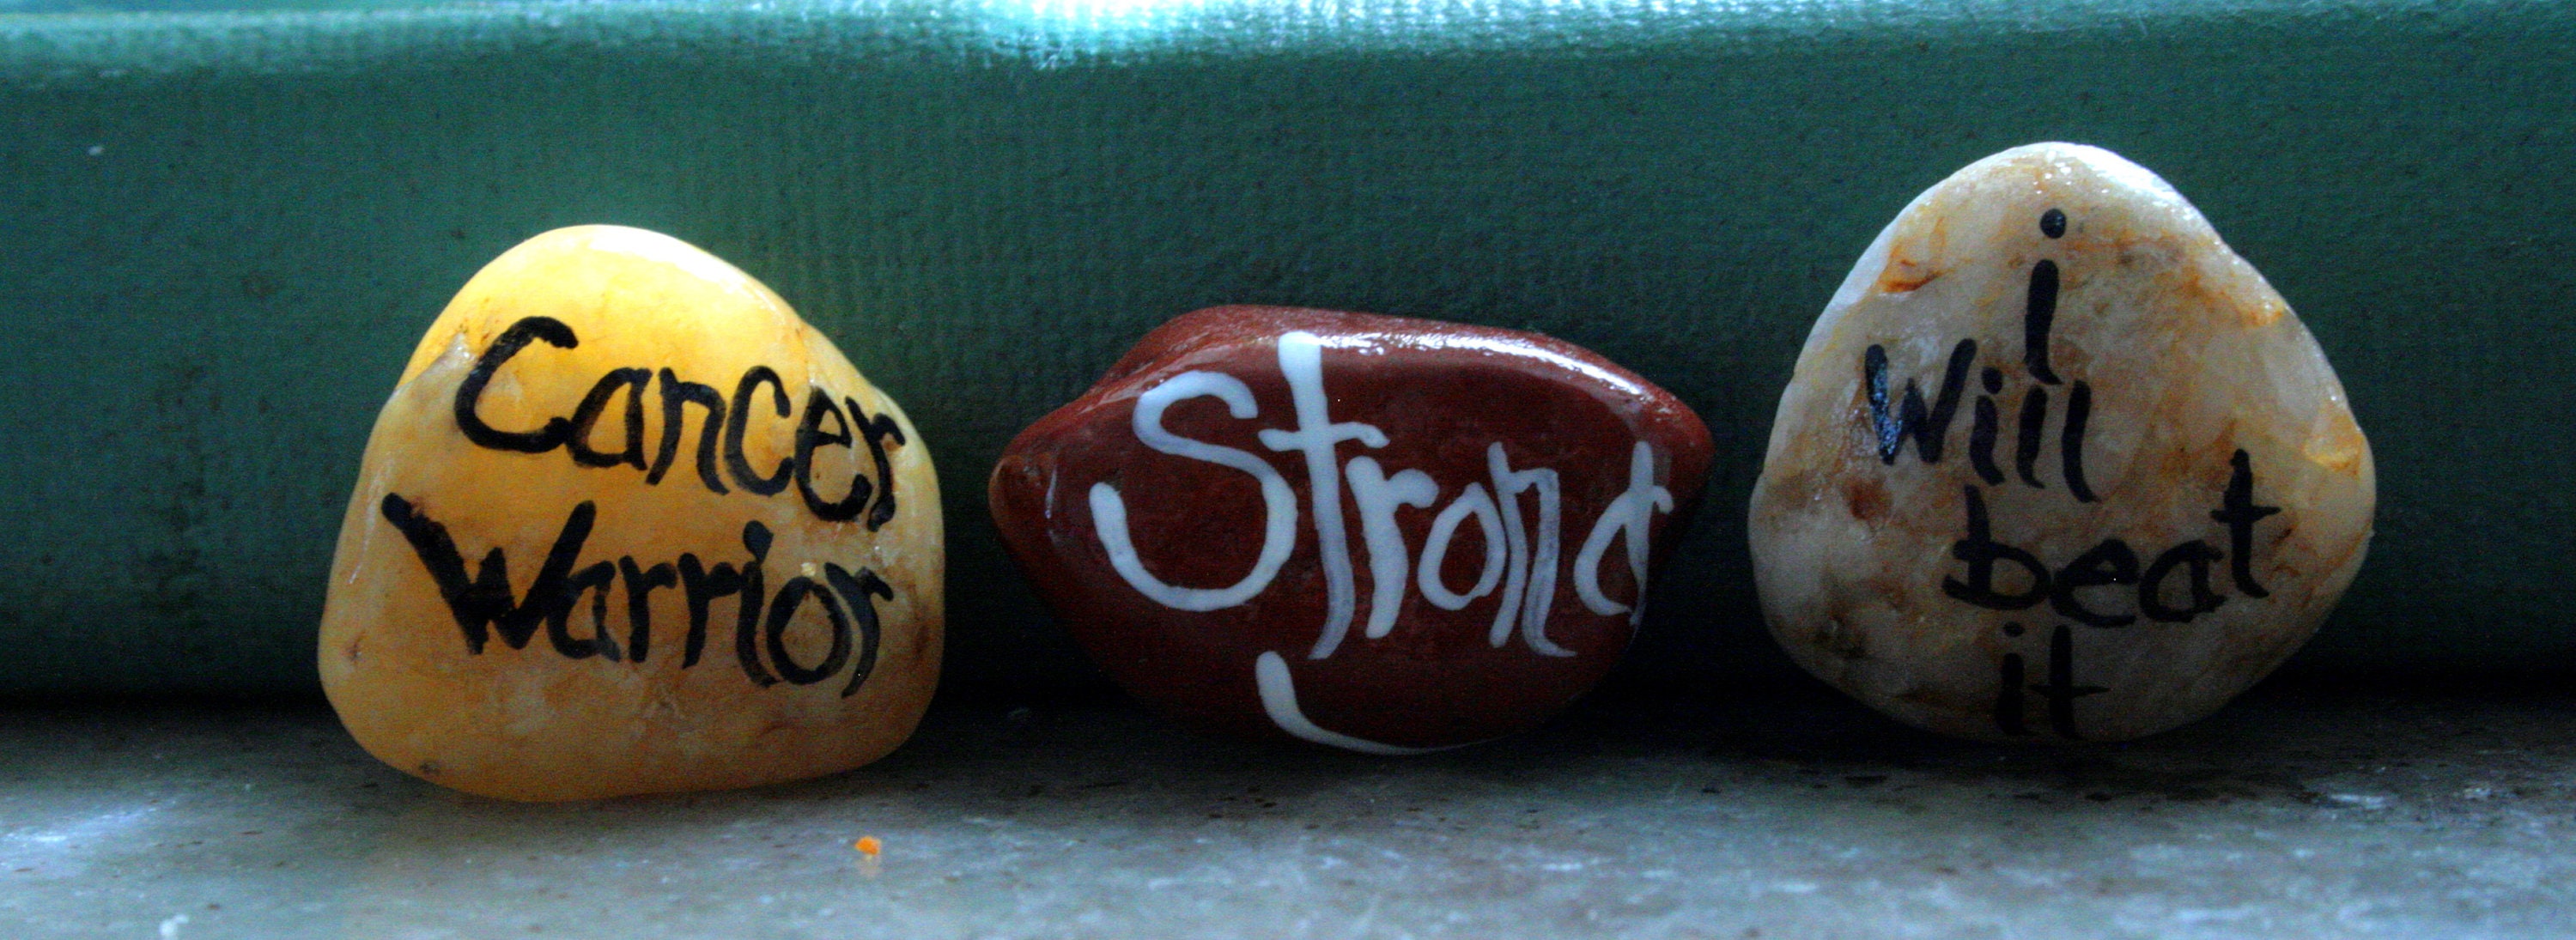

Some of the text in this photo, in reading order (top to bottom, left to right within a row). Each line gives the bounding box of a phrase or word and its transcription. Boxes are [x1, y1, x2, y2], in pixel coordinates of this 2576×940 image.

[2024, 208, 2067, 385] i
[454, 315, 906, 532] Cancer
[380, 492, 893, 698] Warrior
[1941, 449, 2281, 628] beat
[1994, 622, 2111, 739] it
